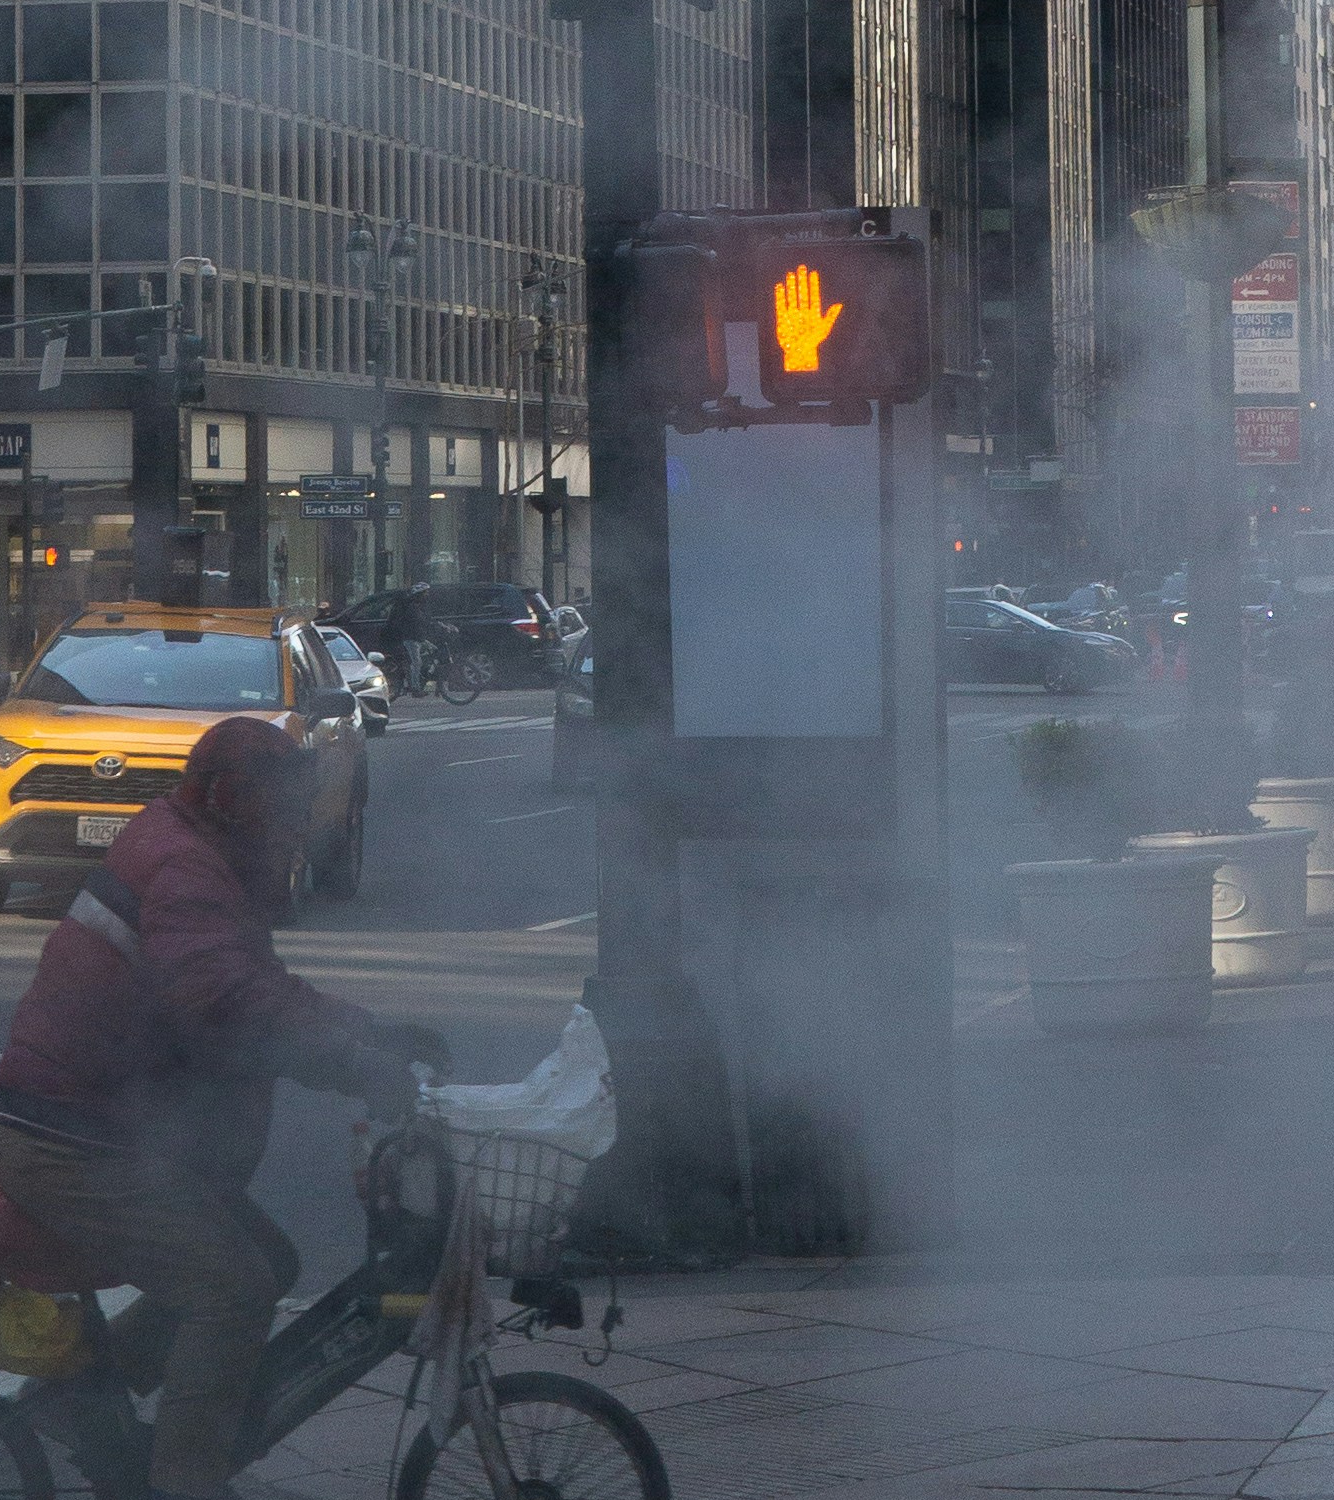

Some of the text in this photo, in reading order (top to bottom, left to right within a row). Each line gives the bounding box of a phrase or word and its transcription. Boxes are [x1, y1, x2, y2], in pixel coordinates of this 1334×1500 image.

[306, 504, 364, 514] East 42nd St
